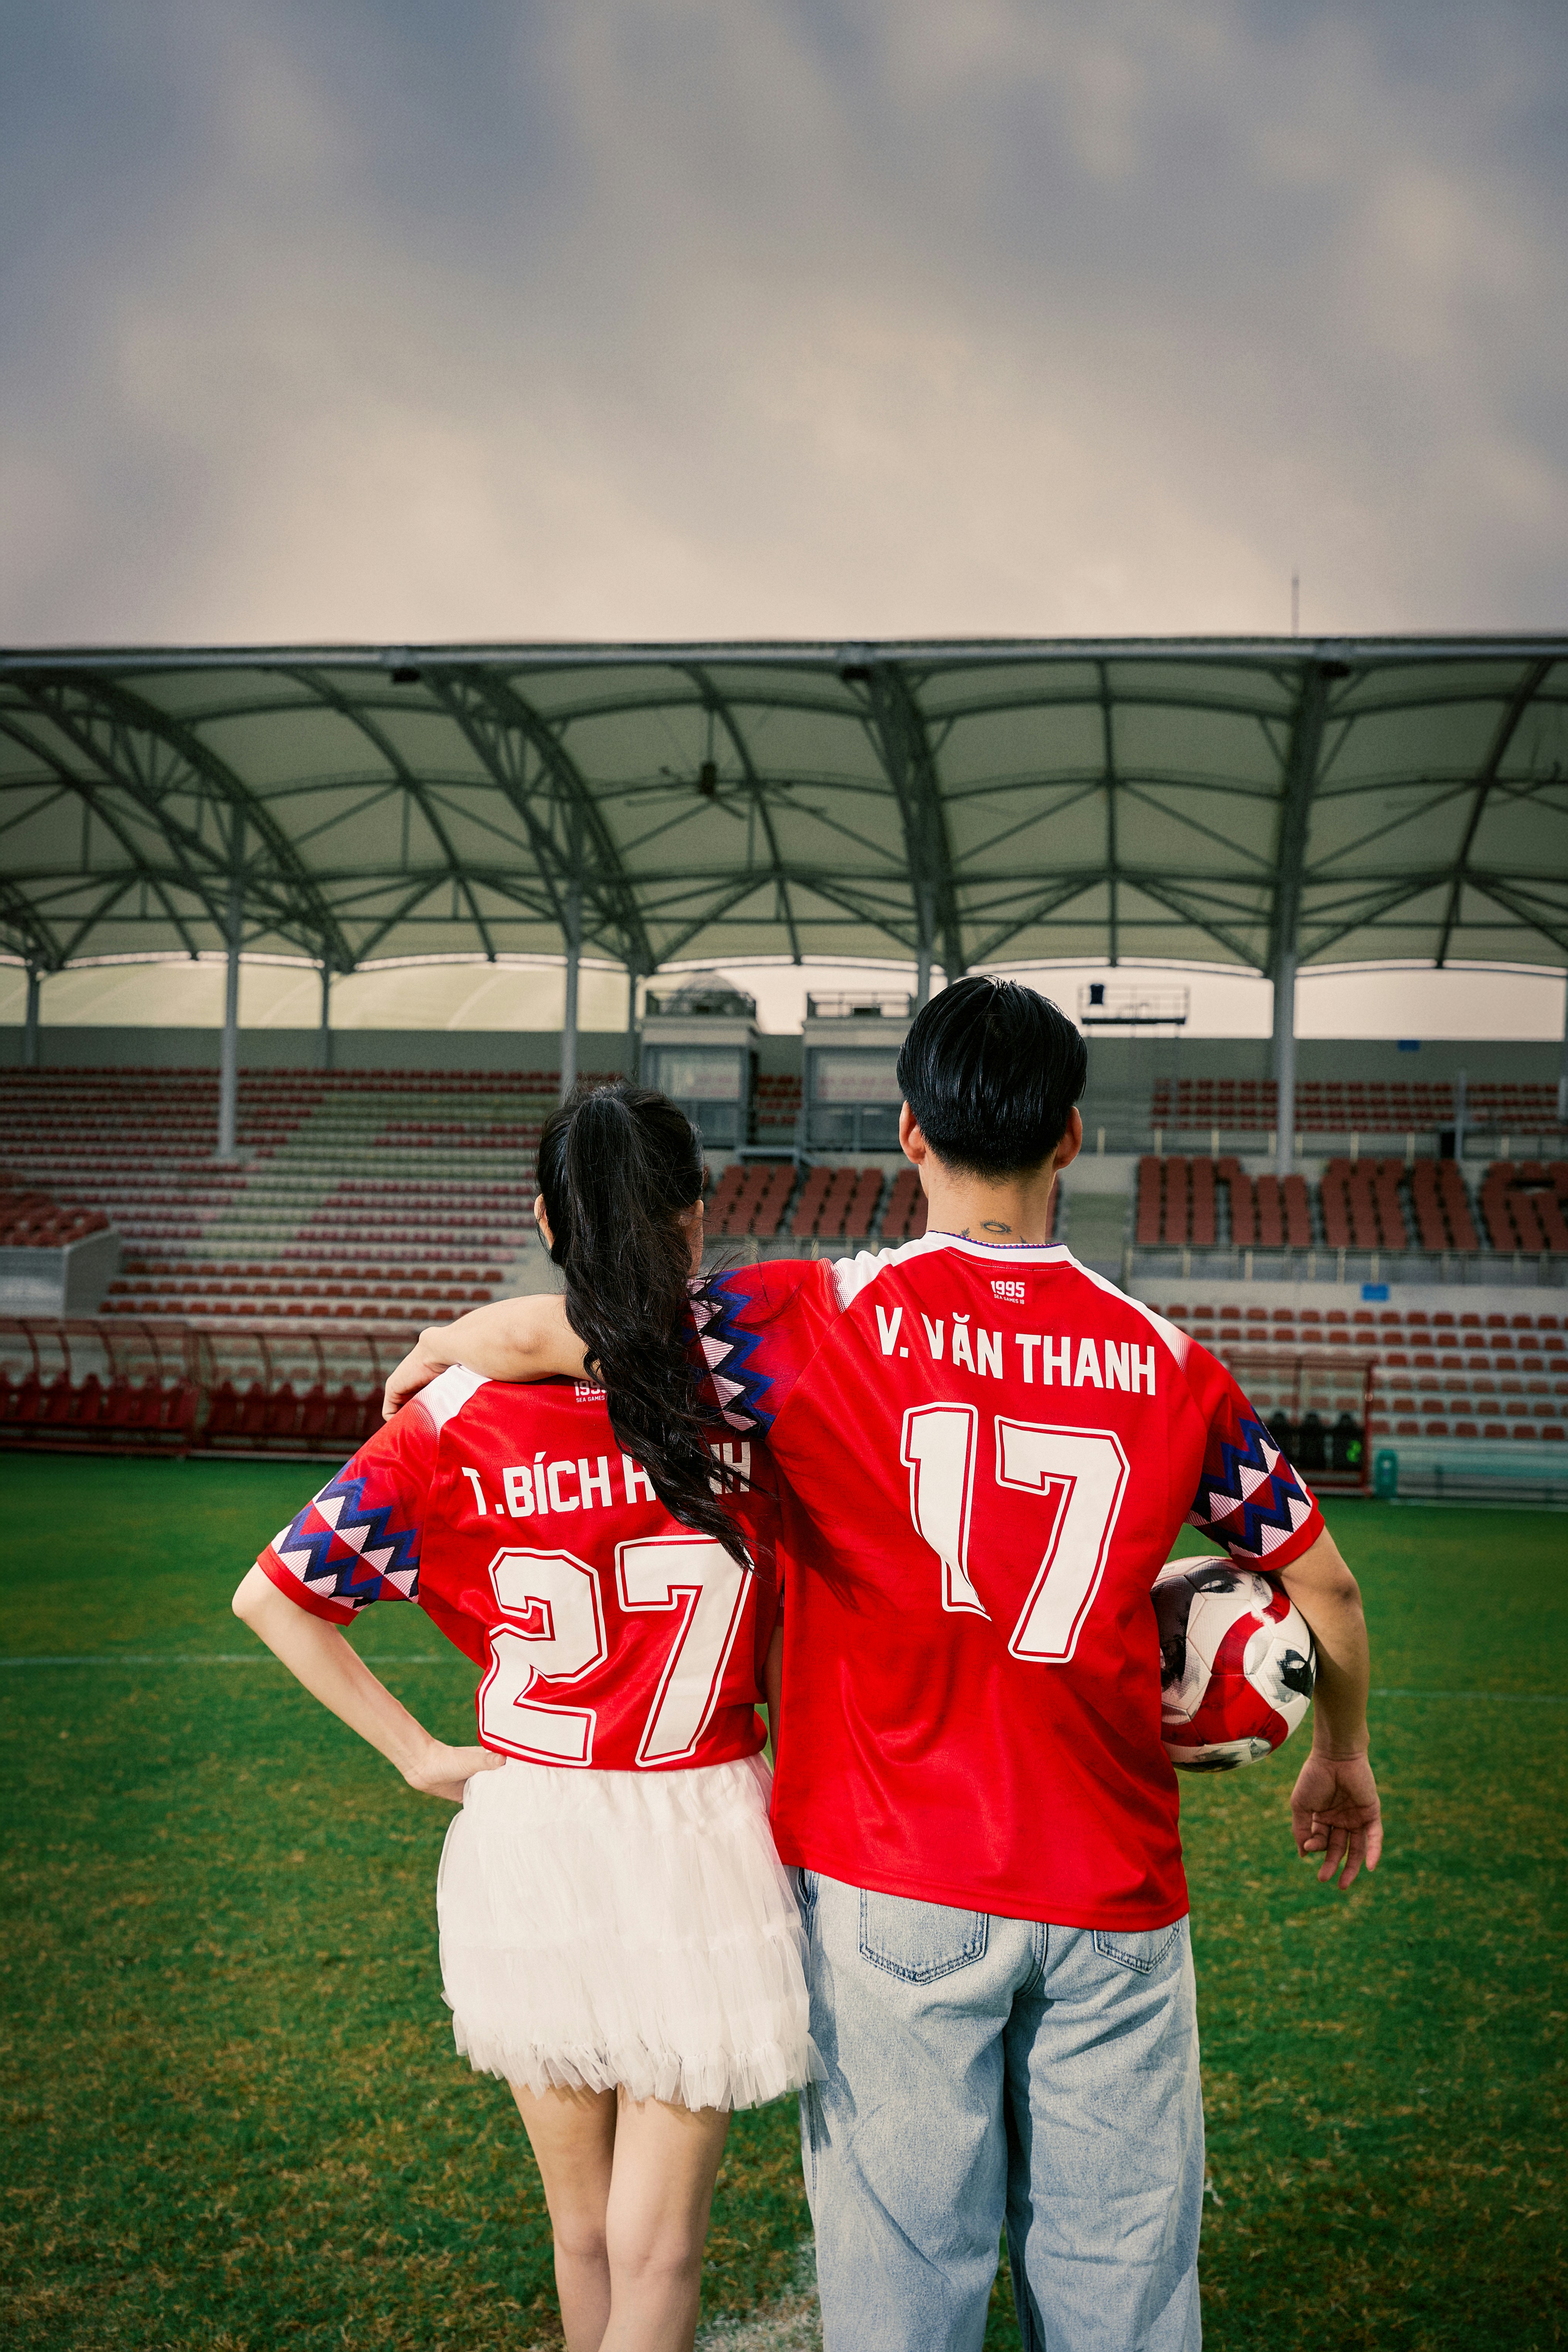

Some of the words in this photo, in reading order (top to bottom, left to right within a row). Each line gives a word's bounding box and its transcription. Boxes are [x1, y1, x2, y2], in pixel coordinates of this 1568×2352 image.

[991, 1281, 1025, 1297] 1995
[574, 1381, 607, 1396] 199
[876, 1305, 908, 1358] V.
[921, 1312, 1003, 1379] VĂN
[1015, 1333, 1155, 1395] THANH
[900, 1402, 1130, 1663] 17
[478, 1534, 754, 1767] 27
